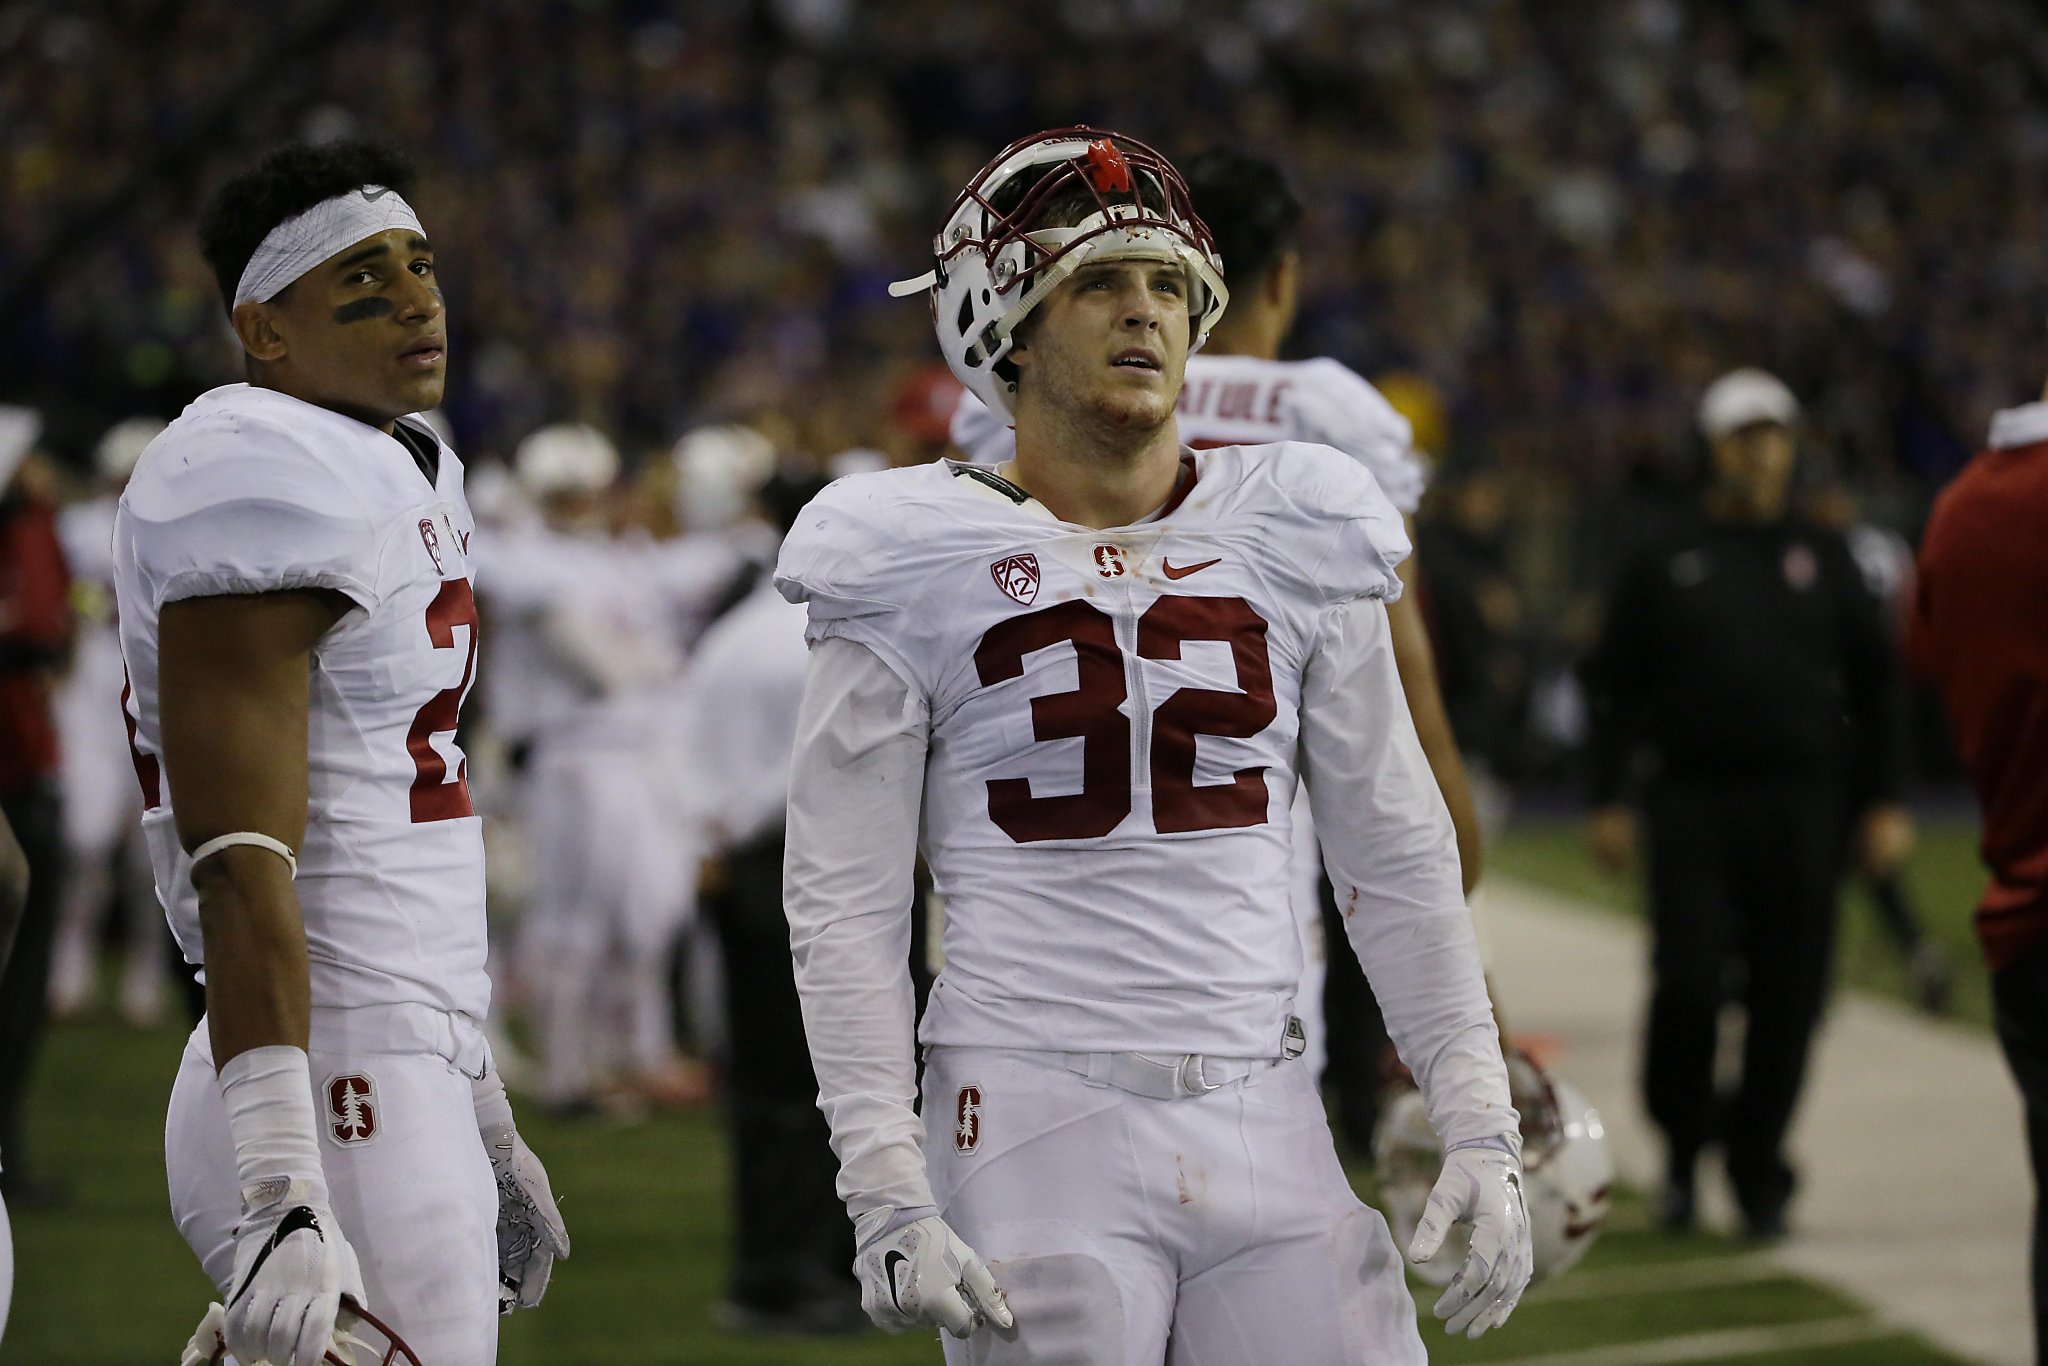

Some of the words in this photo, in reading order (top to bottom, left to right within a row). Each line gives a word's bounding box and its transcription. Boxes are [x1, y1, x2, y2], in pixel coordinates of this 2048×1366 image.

[993, 556, 1037, 590] PAC
[1009, 577, 1034, 597] 12
[973, 594, 1278, 844] 32
